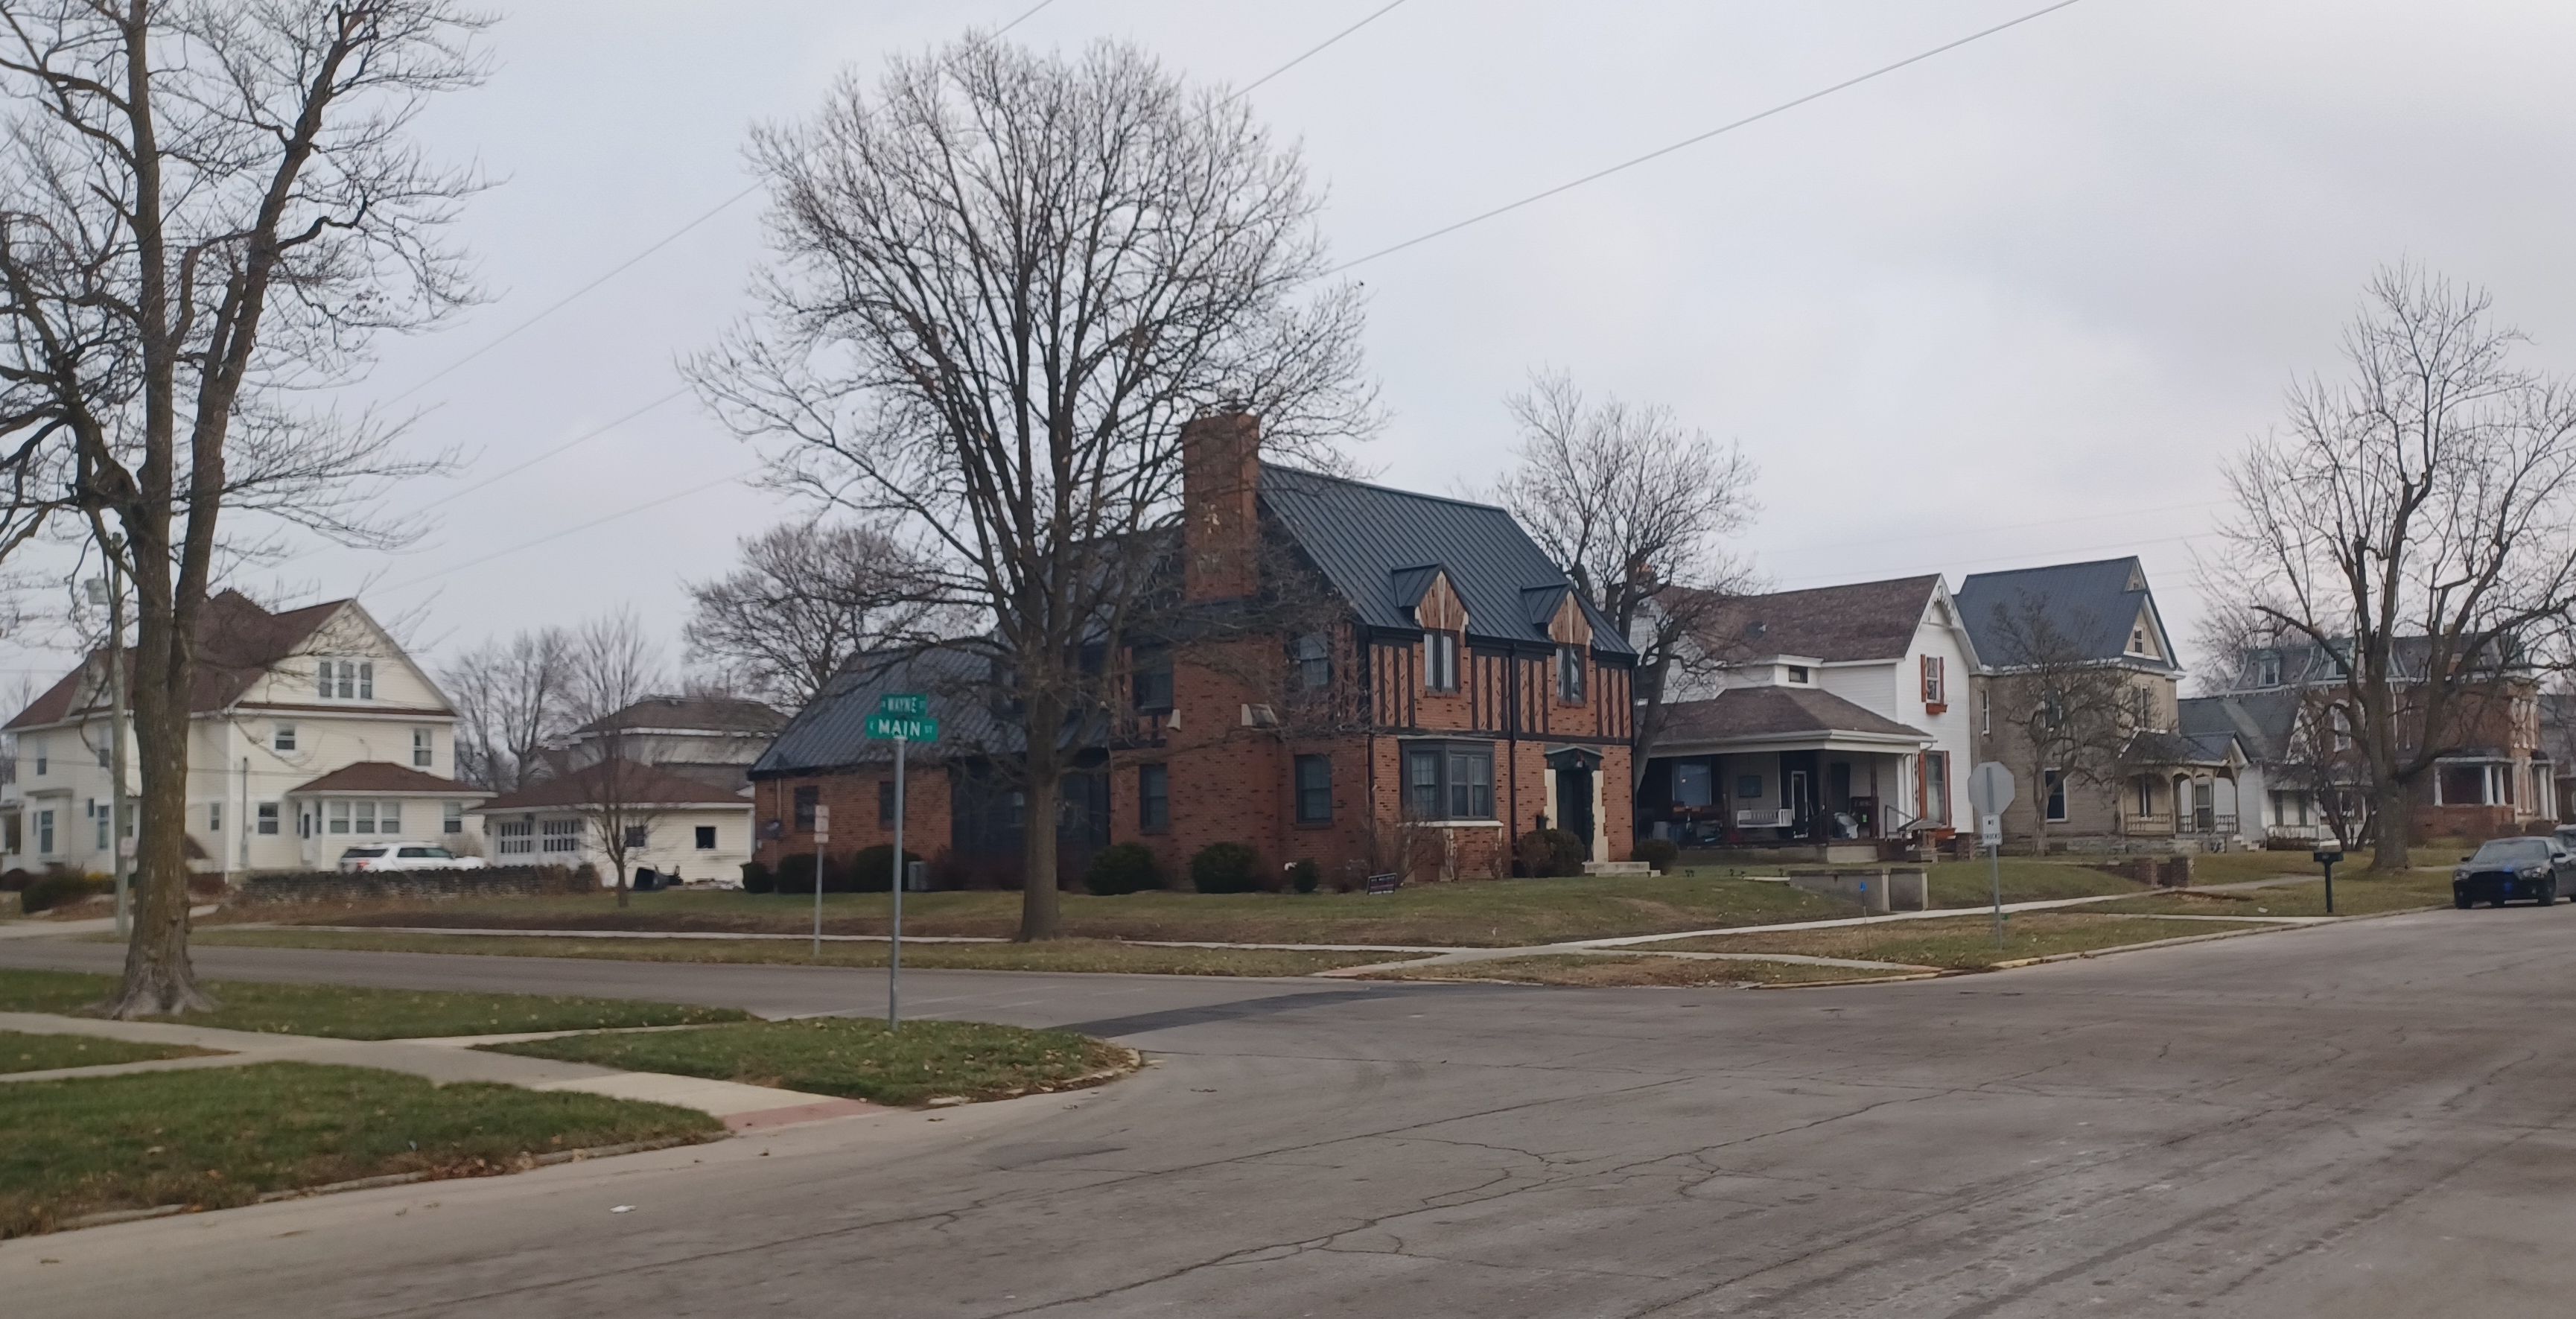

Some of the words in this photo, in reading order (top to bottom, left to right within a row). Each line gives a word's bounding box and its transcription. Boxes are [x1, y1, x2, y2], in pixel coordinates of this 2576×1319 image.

[888, 697, 917, 713] WAYNE
[878, 719, 920, 737] MAIN
[924, 725, 933, 734] ST
